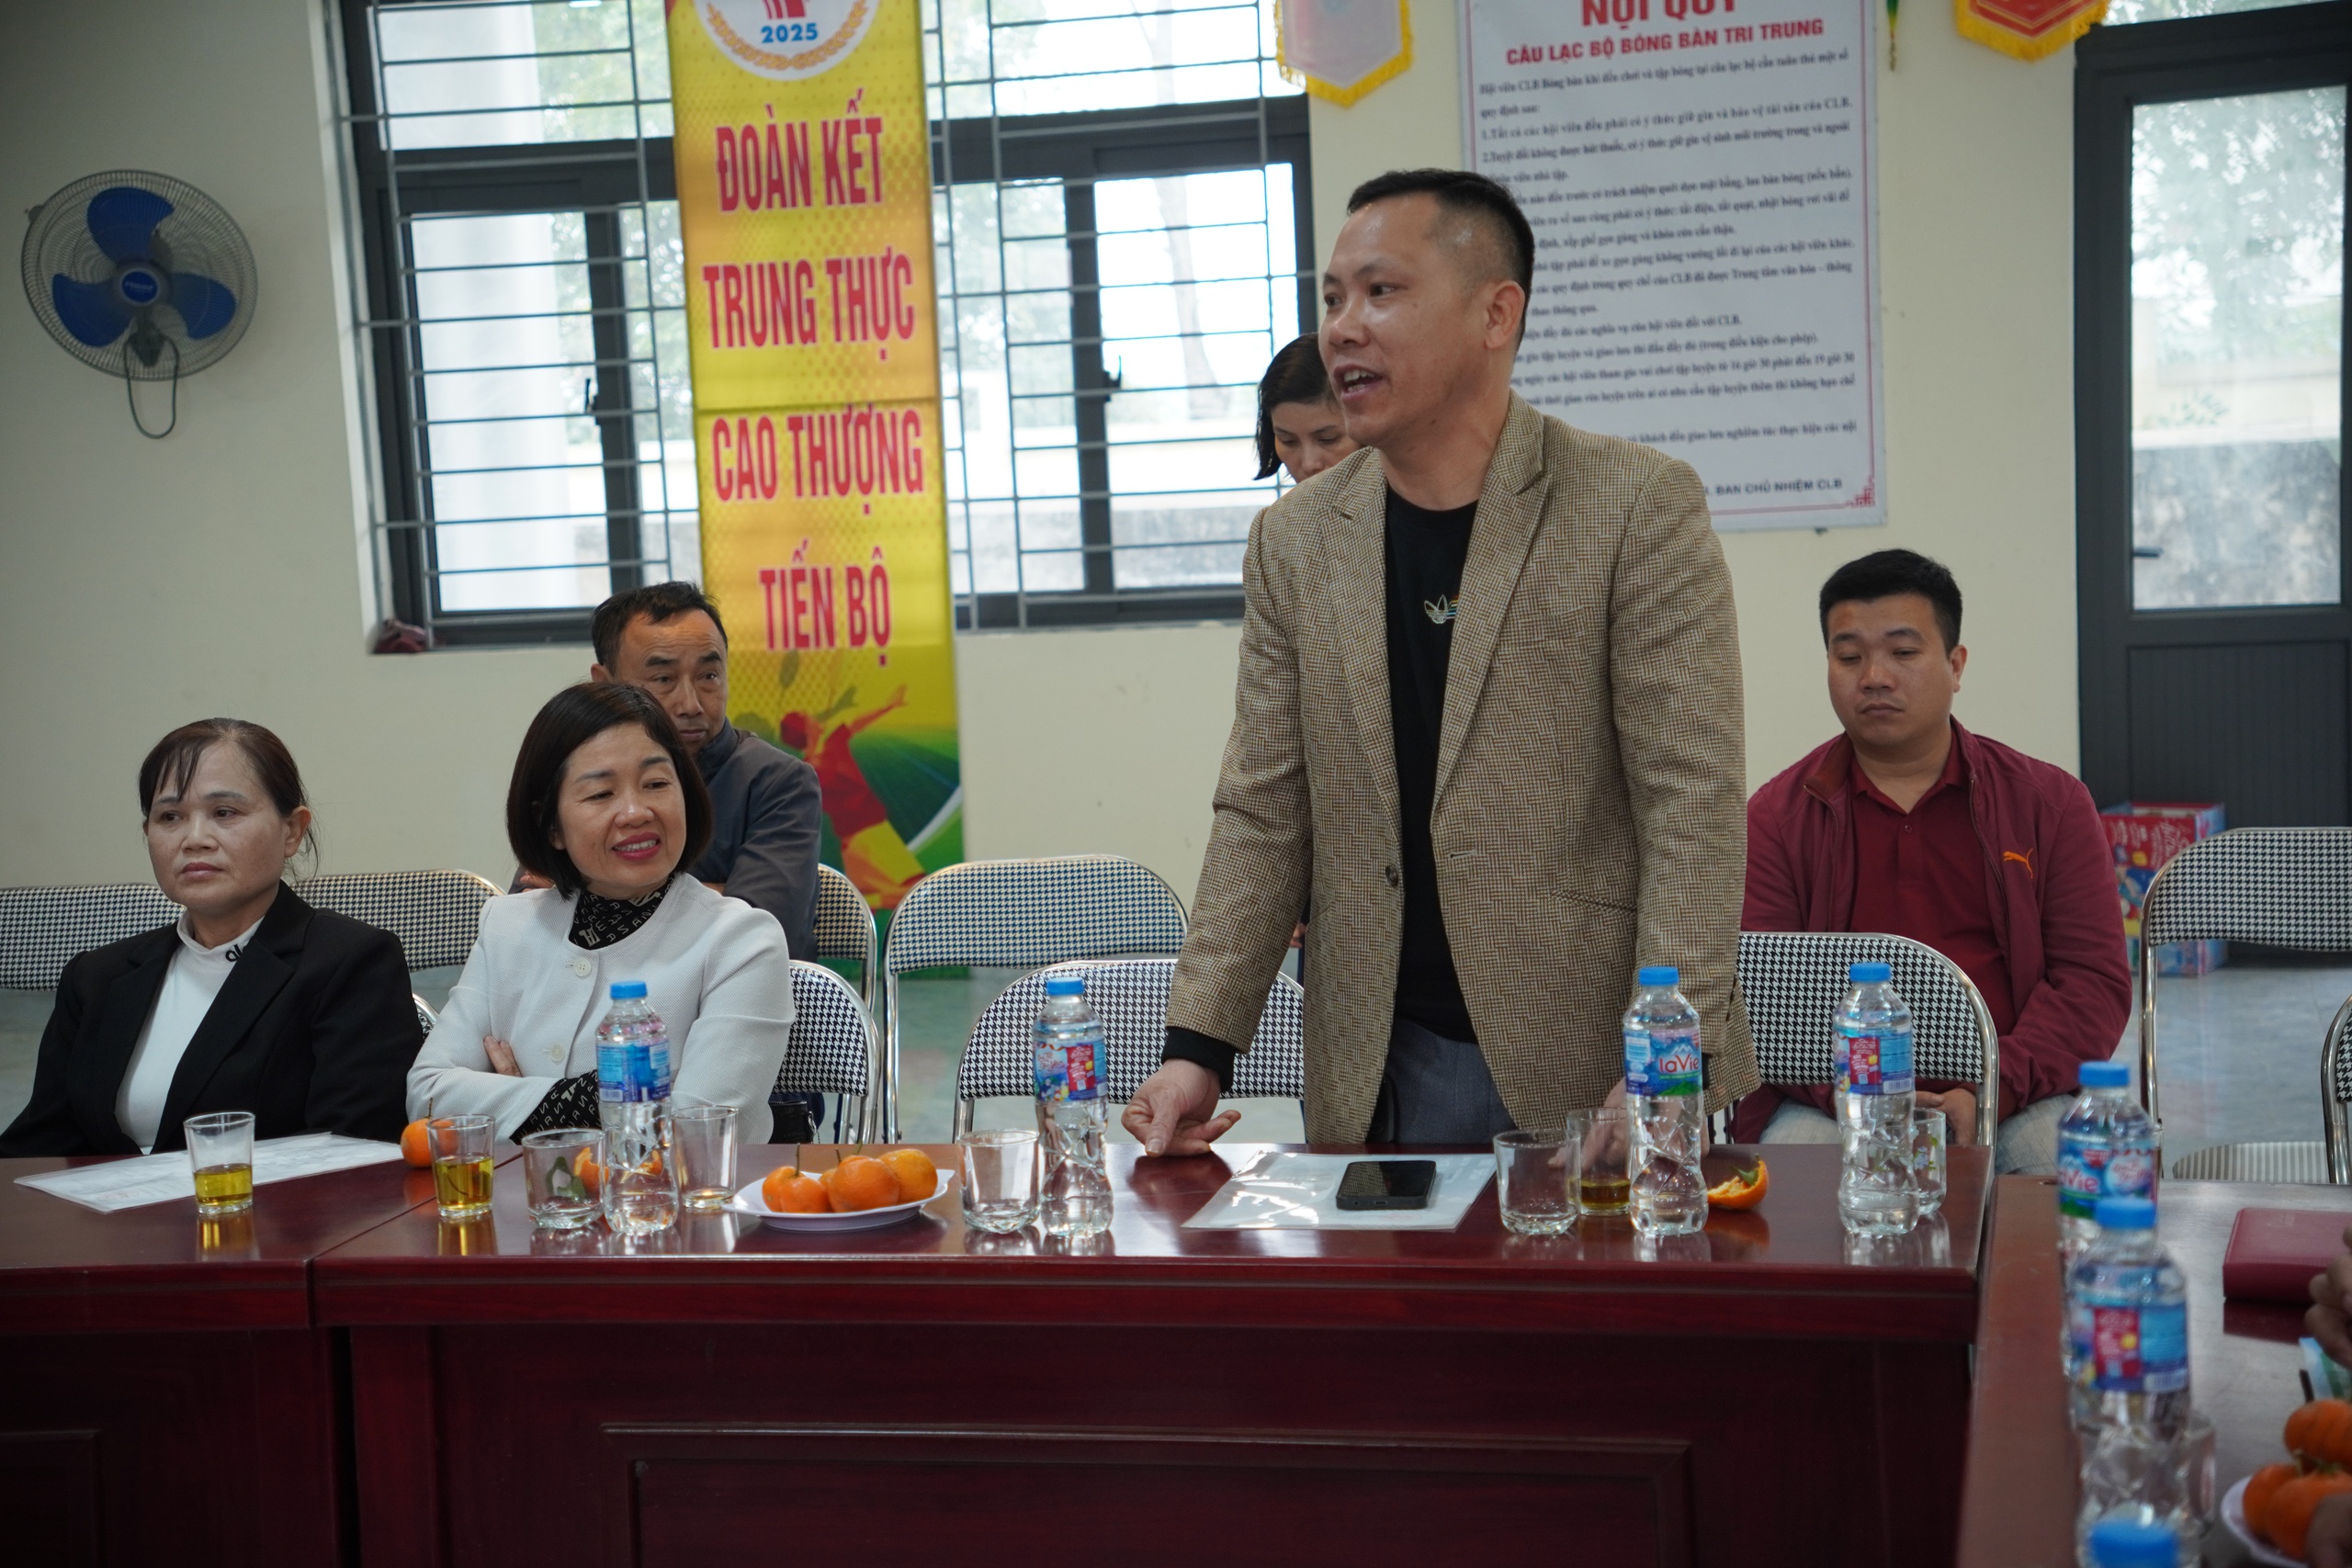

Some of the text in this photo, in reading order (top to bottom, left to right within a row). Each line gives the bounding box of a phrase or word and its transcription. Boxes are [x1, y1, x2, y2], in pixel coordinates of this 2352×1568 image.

[761, 23, 819, 43] 2025
[1507, 18, 1823, 65] CÂU LẠC BỘ BÓNG BÀN TRI TRUNG
[1518, 79, 1539, 90] CLB
[715, 88, 883, 212] ĐOÀN KẾT
[702, 246, 915, 361] TRUNG THỰC
[712, 401, 923, 515] CAO THƯỢNG
[1716, 484, 1740, 495] BAN
[1818, 478, 1842, 490] CLB
[759, 538, 891, 667] TIẾN BỘ
[1659, 1053, 1699, 1073] laVie
[2058, 1168, 2099, 1193] Vie
